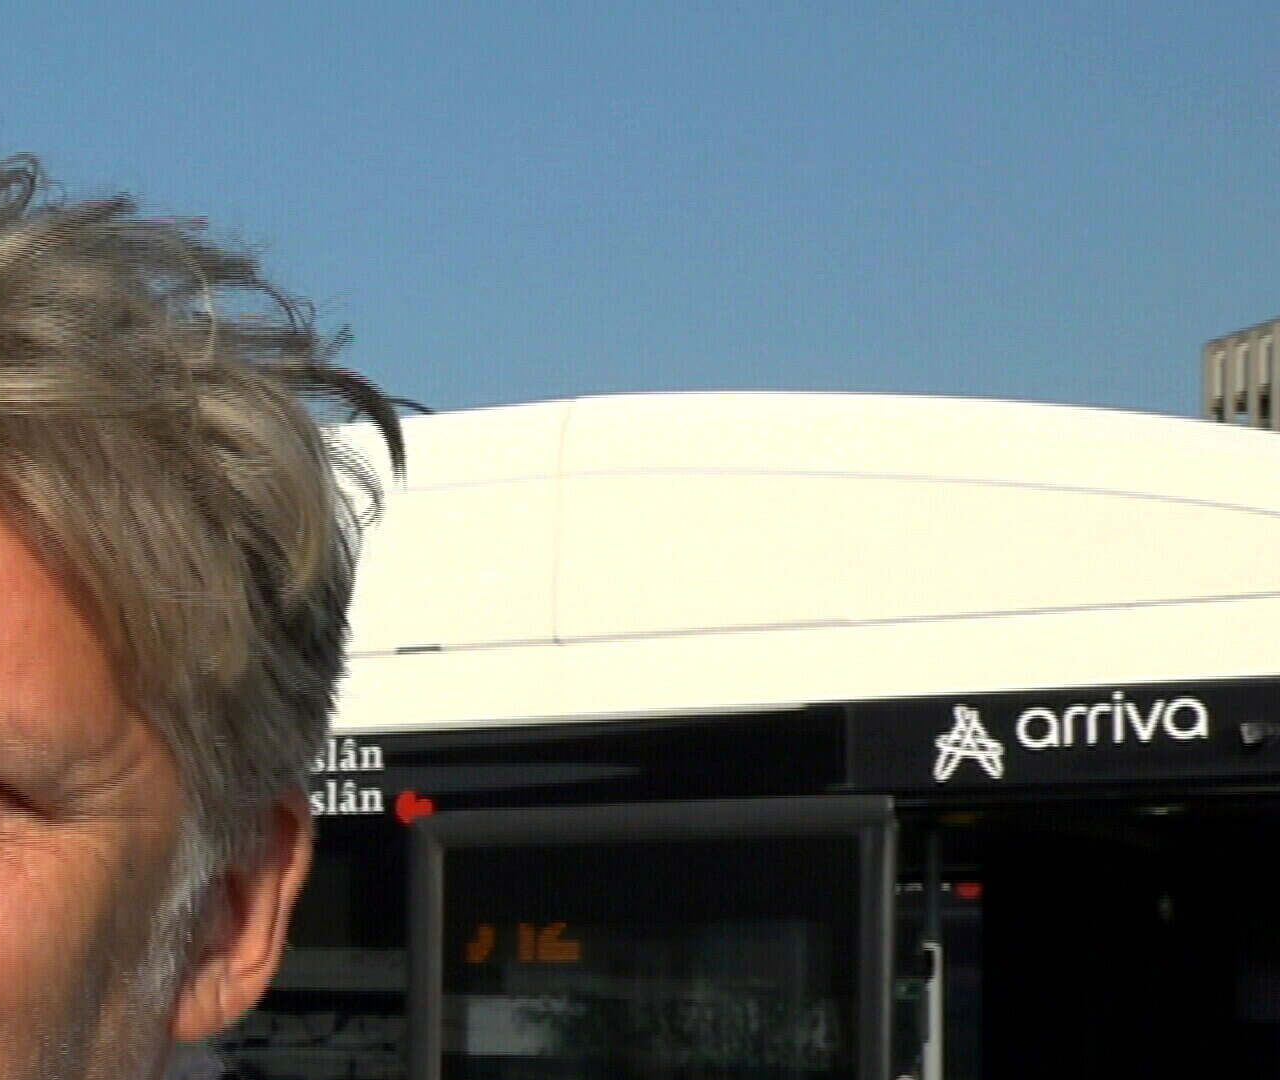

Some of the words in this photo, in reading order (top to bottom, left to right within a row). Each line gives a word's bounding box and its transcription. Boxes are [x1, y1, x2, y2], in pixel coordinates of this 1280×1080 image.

[1017, 691, 1208, 749] arriva
[310, 739, 384, 772] slân
[309, 779, 384, 816] slân
